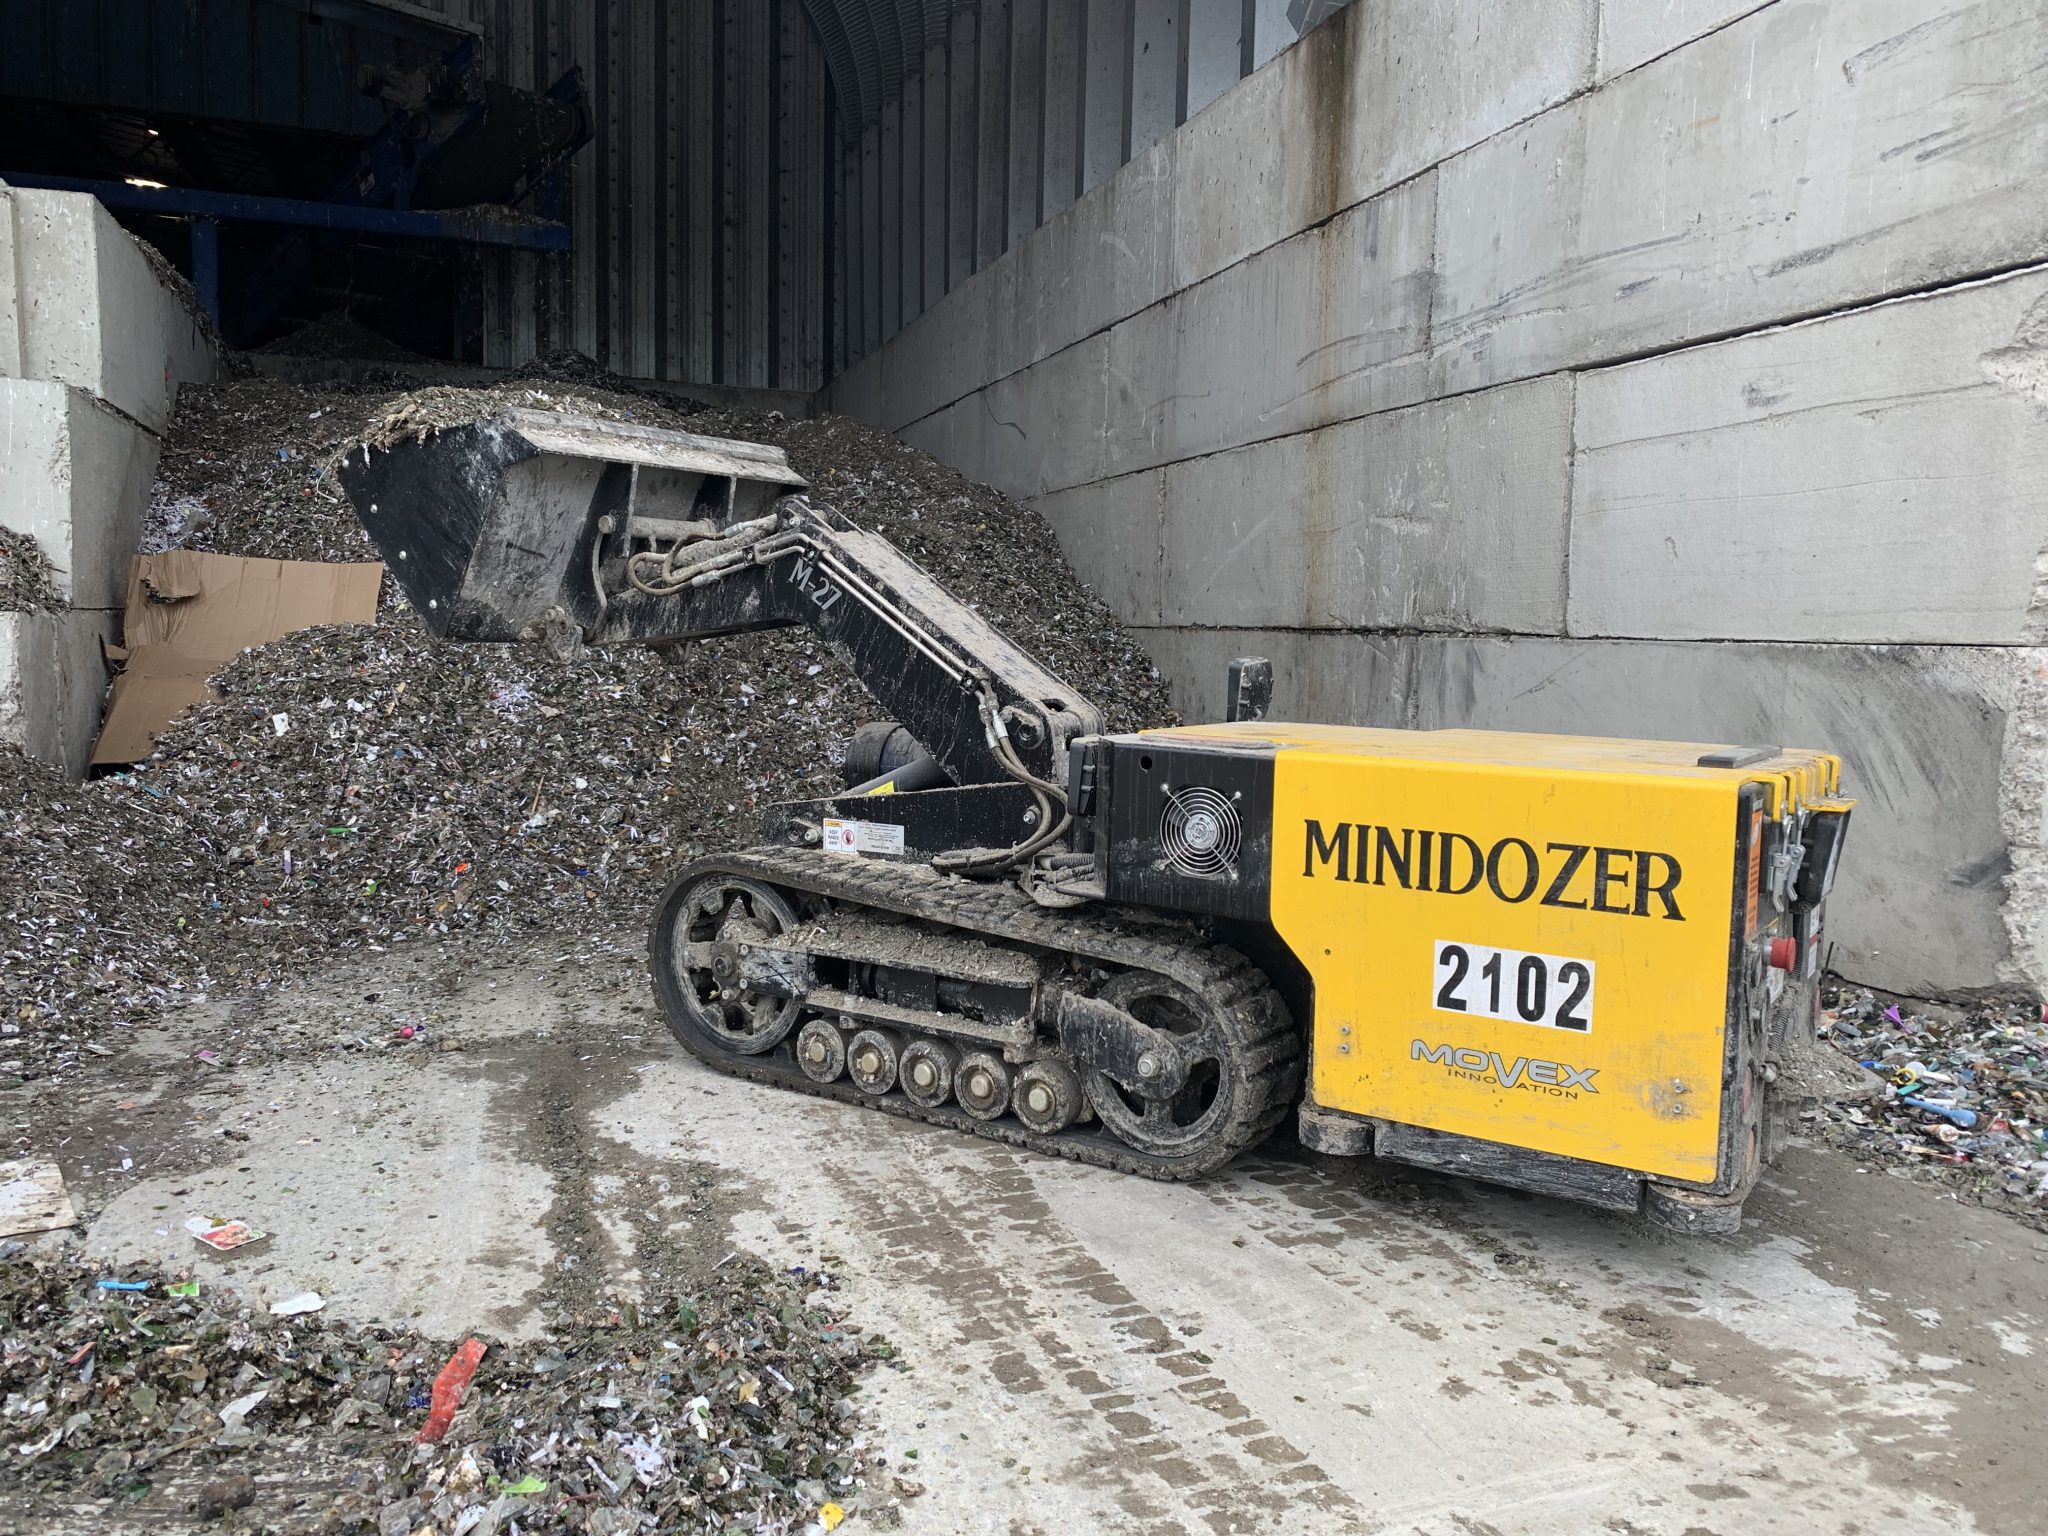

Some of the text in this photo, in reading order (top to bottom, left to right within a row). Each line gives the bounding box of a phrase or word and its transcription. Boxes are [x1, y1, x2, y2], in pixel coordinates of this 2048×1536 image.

[788, 557, 842, 610] M-27
[1302, 819, 1686, 921] MINIDOZER
[1436, 944, 1592, 1032] 2102
[1411, 1039, 1600, 1094] MOVEX
